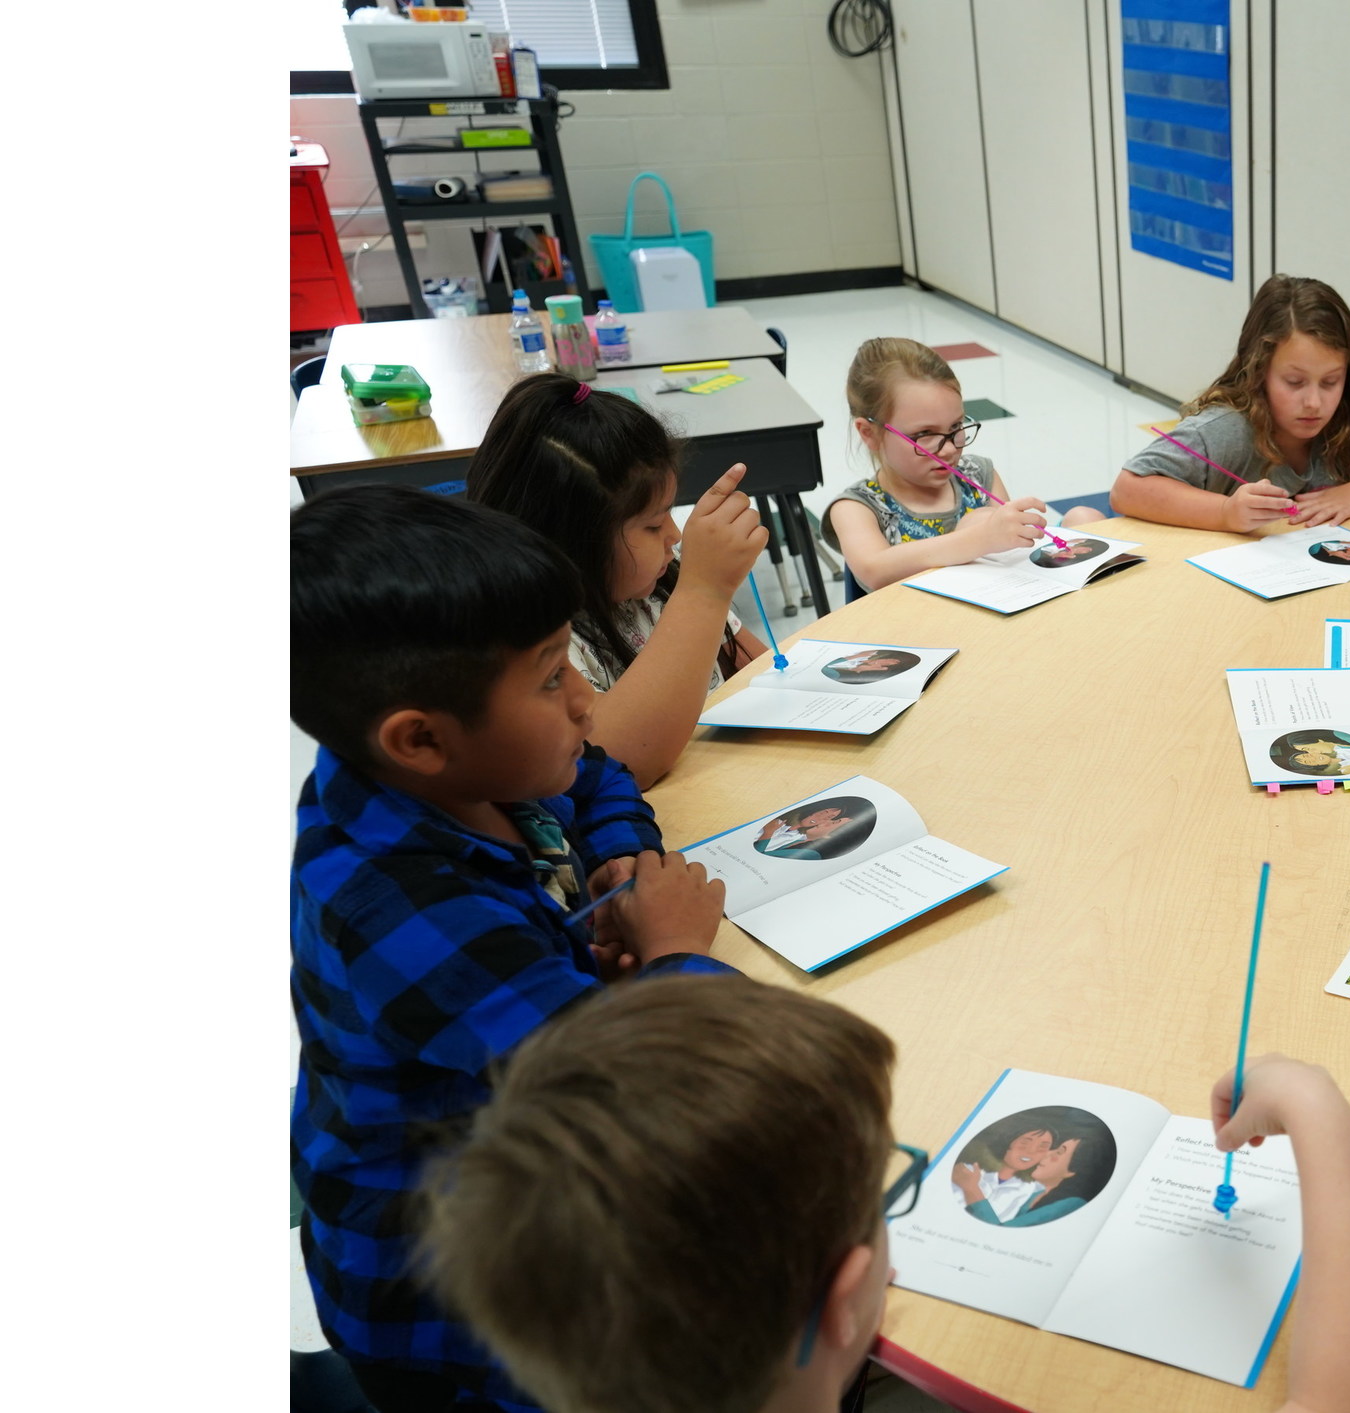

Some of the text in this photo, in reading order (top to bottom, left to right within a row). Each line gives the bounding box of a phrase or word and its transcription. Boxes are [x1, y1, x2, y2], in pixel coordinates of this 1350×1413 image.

[1175, 1136, 1202, 1147] Reflect
[1151, 1176, 1212, 1194] My Perspective
